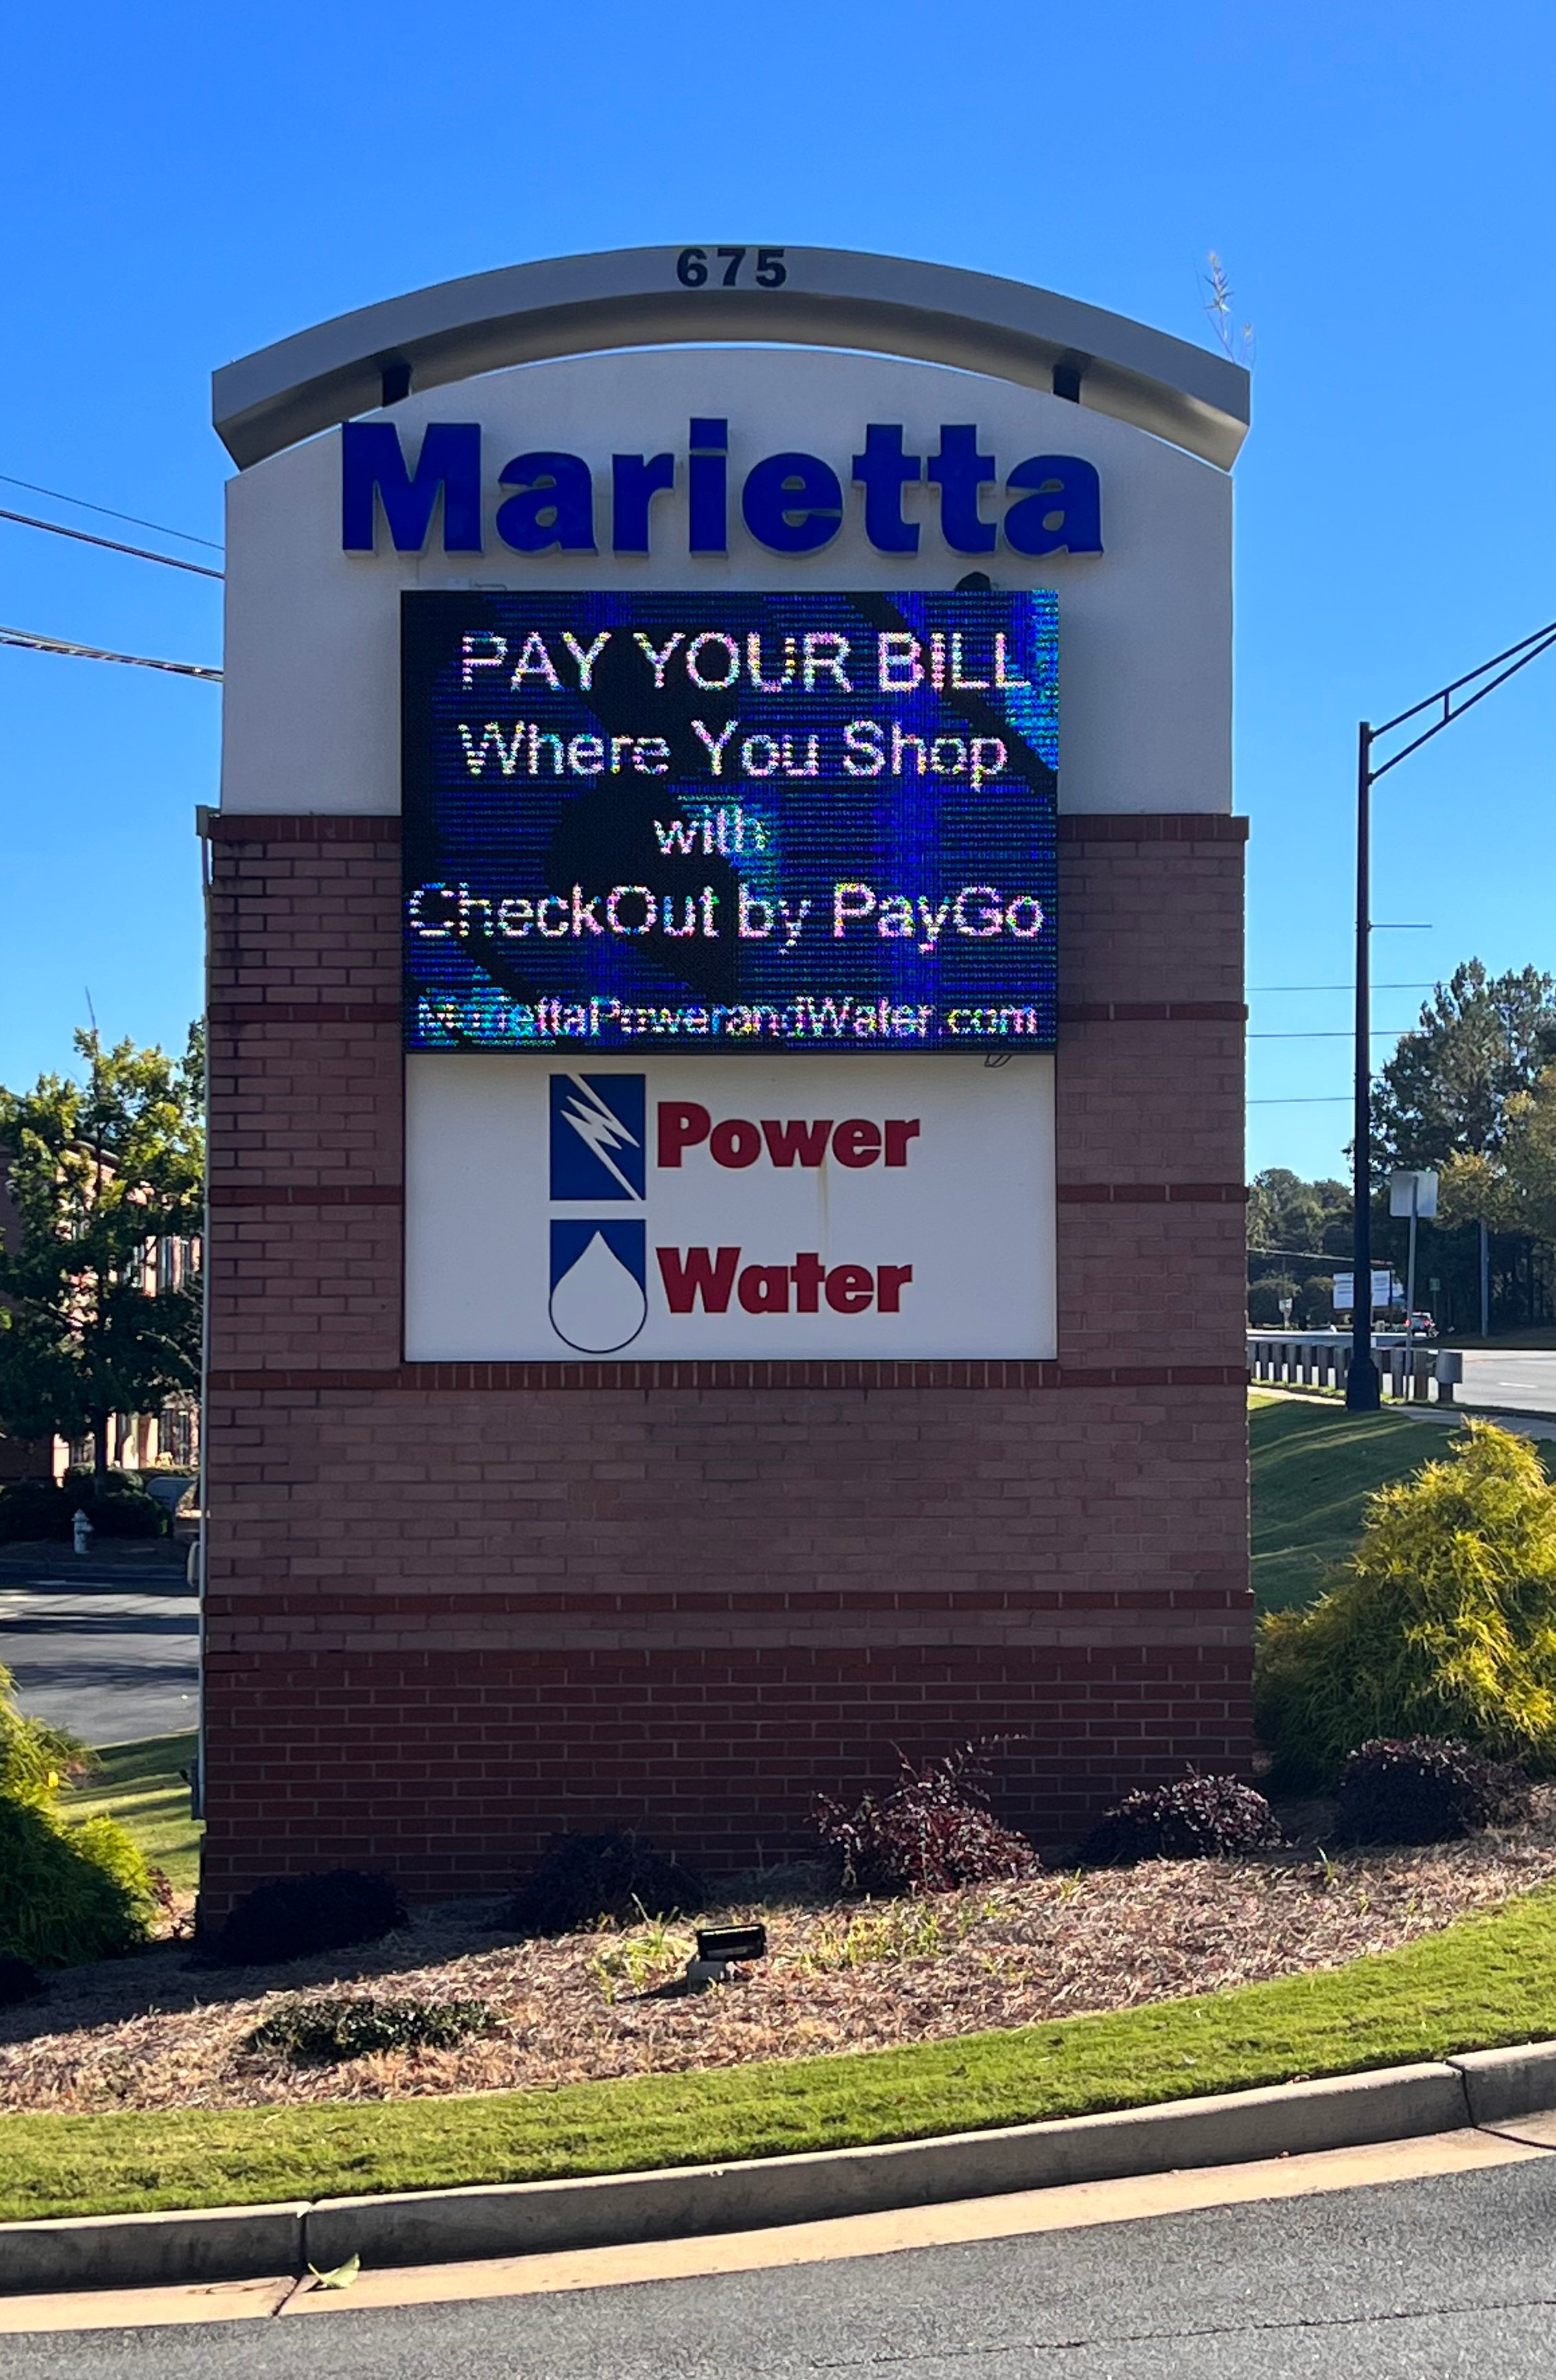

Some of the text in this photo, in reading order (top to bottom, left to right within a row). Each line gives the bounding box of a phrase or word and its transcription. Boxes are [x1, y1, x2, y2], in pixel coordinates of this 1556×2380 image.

[677, 247, 787, 288] 675
[342, 417, 1103, 557] Marietta
[461, 631, 1032, 692] PAY YOUR BILL
[458, 718, 1007, 791] Where You Shop
[653, 806, 767, 855] with
[408, 882, 1044, 955] CheckOut by PayGo
[656, 1101, 921, 1169] Power
[655, 1246, 914, 1315] Water
